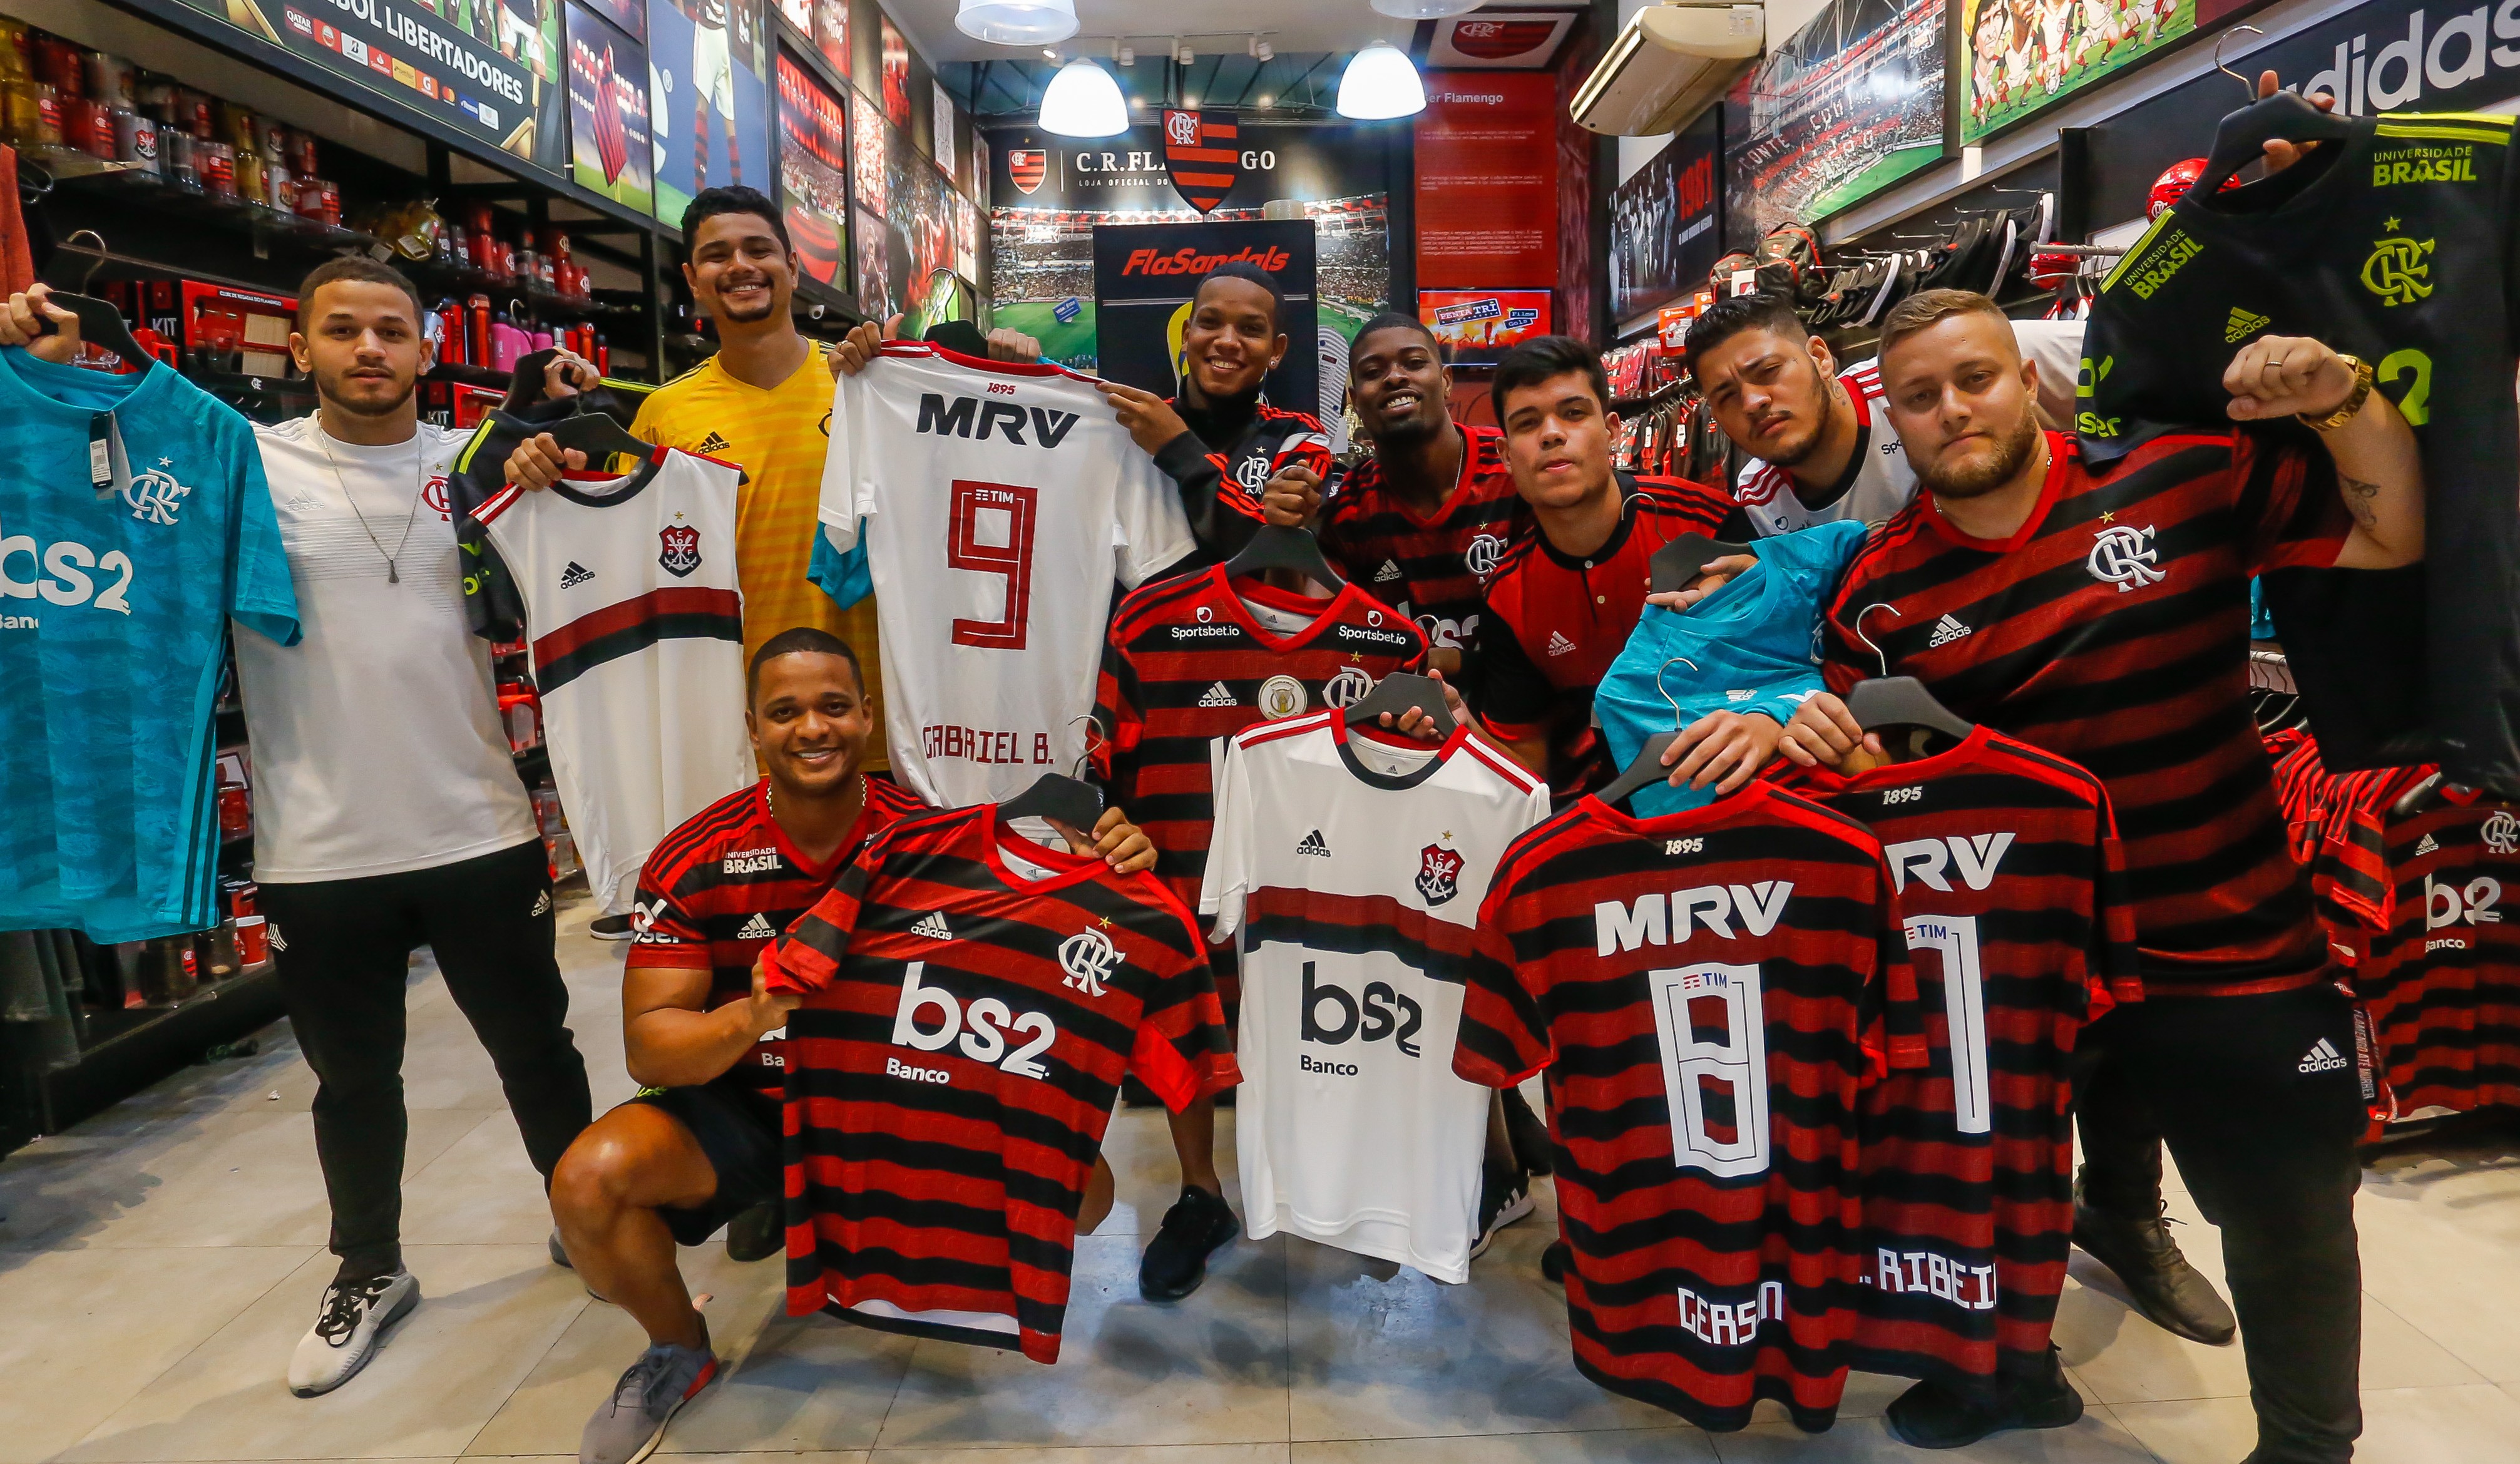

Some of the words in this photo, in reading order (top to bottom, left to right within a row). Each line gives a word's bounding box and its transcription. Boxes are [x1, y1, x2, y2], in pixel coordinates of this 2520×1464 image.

[286, 10, 312, 29] QATAR
[385, 6, 525, 105] LIBERTADORES
[2286, 0, 2520, 116] didas
[1444, 93, 1504, 105] Flamengo
[2374, 146, 2473, 163] UNIVERSIDADE
[2373, 158, 2477, 187] BRASIL
[2124, 228, 2186, 286] UNIVERSIDADE
[2131, 237, 2204, 300] BRASIL
[1439, 308, 1472, 320] PENTA
[1508, 319, 1528, 327] Gols
[152, 317, 178, 337] KIT
[2225, 315, 2272, 343] adidas
[986, 382, 1016, 396] 1895
[427, 410, 449, 426] KIT
[915, 393, 1080, 449] MRV
[2074, 411, 2122, 438] ser
[698, 441, 730, 455] adidas
[284, 500, 325, 512] adidas
[991, 490, 1014, 504] TIM
[560, 570, 596, 591] adidas
[1172, 626, 1240, 638] Sportsbet.io
[1338, 625, 1406, 645] Sportsbet.io
[1929, 625, 1972, 647] adidas
[1198, 696, 1237, 708] adidas
[922, 725, 1025, 765] GABRIEL
[1033, 732, 1055, 765] B.
[1882, 786, 1923, 806] 1895
[1664, 837, 1704, 856] 1895
[723, 854, 782, 874] BRASIL
[1884, 832, 2017, 896] RV
[1594, 880, 1795, 958] MRV
[737, 928, 777, 939] adidas
[910, 923, 953, 941] adidas
[1917, 924, 1947, 941] TIM
[2424, 938, 2466, 953] Banco
[1702, 972, 1728, 990] TIM
[890, 960, 1057, 1080] bs2
[1300, 960, 1423, 1060] bs2
[886, 1057, 950, 1085] Banco
[1300, 1055, 1359, 1077] Banco
[1647, 961, 1770, 1179] 8
[2298, 1055, 2347, 1073] adidas
[1878, 1247, 1997, 1309] RIBEI
[1677, 1281, 1783, 1345] GERSN
